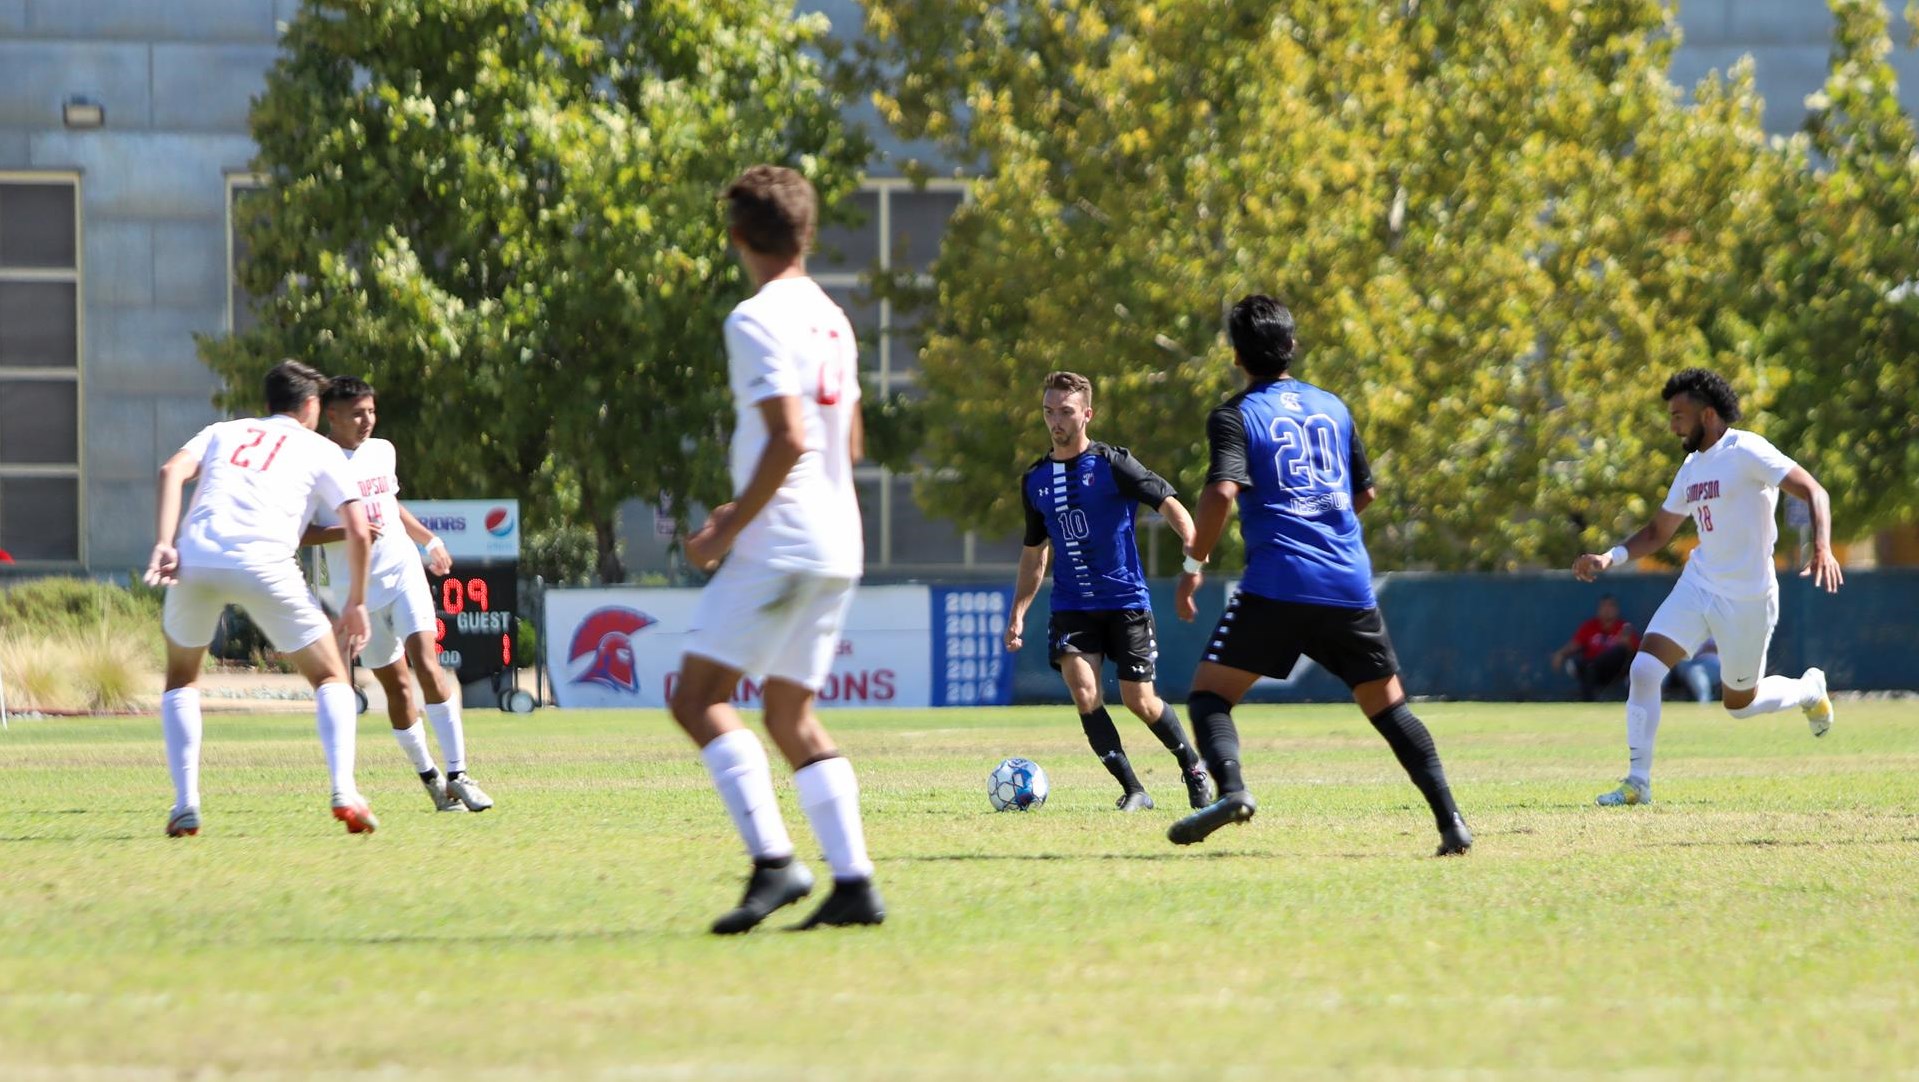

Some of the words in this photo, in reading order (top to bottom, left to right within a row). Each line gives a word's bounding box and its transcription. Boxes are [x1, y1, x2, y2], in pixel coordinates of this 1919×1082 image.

[230, 427, 287, 473] 21
[1270, 413, 1346, 491] 20
[1058, 509, 1090, 541] 10
[1698, 505, 1714, 532] 18
[457, 611, 511, 632] GUEST
